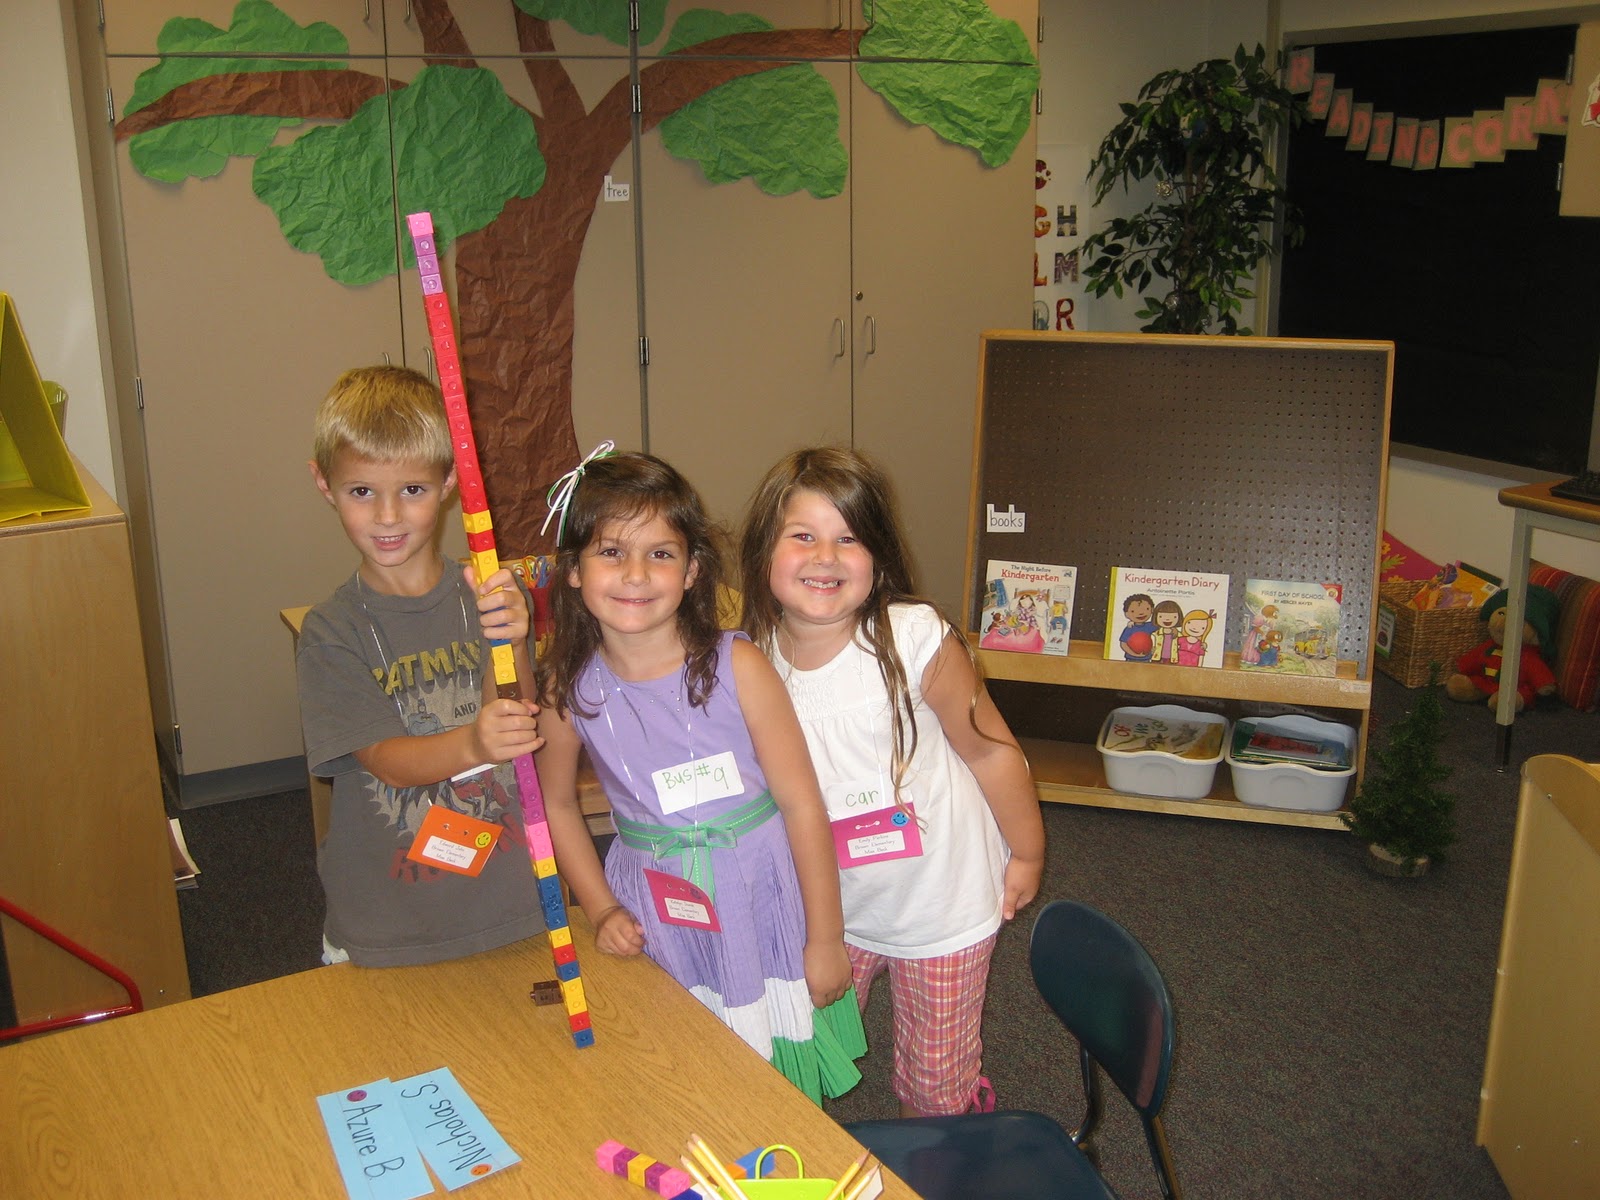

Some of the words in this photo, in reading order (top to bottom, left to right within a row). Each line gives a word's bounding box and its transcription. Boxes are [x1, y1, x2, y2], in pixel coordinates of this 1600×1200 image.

[1289, 55, 1437, 166] READING
[606, 182, 629, 198] tree
[1057, 205, 1077, 236] H
[1054, 252, 1079, 283] M
[1056, 298, 1075, 331] R
[990, 509, 1023, 528] books
[1001, 569, 1060, 583] Kindergarten
[1021, 565, 1035, 573] Night
[1124, 573, 1190, 588] Kindergarten
[1191, 576, 1220, 592] Diary
[455, 702, 477, 719] AND
[662, 768, 693, 790] Bus
[845, 790, 879, 808] car
[342, 1103, 383, 1157] Azure
[424, 1098, 492, 1171] Nicholas
